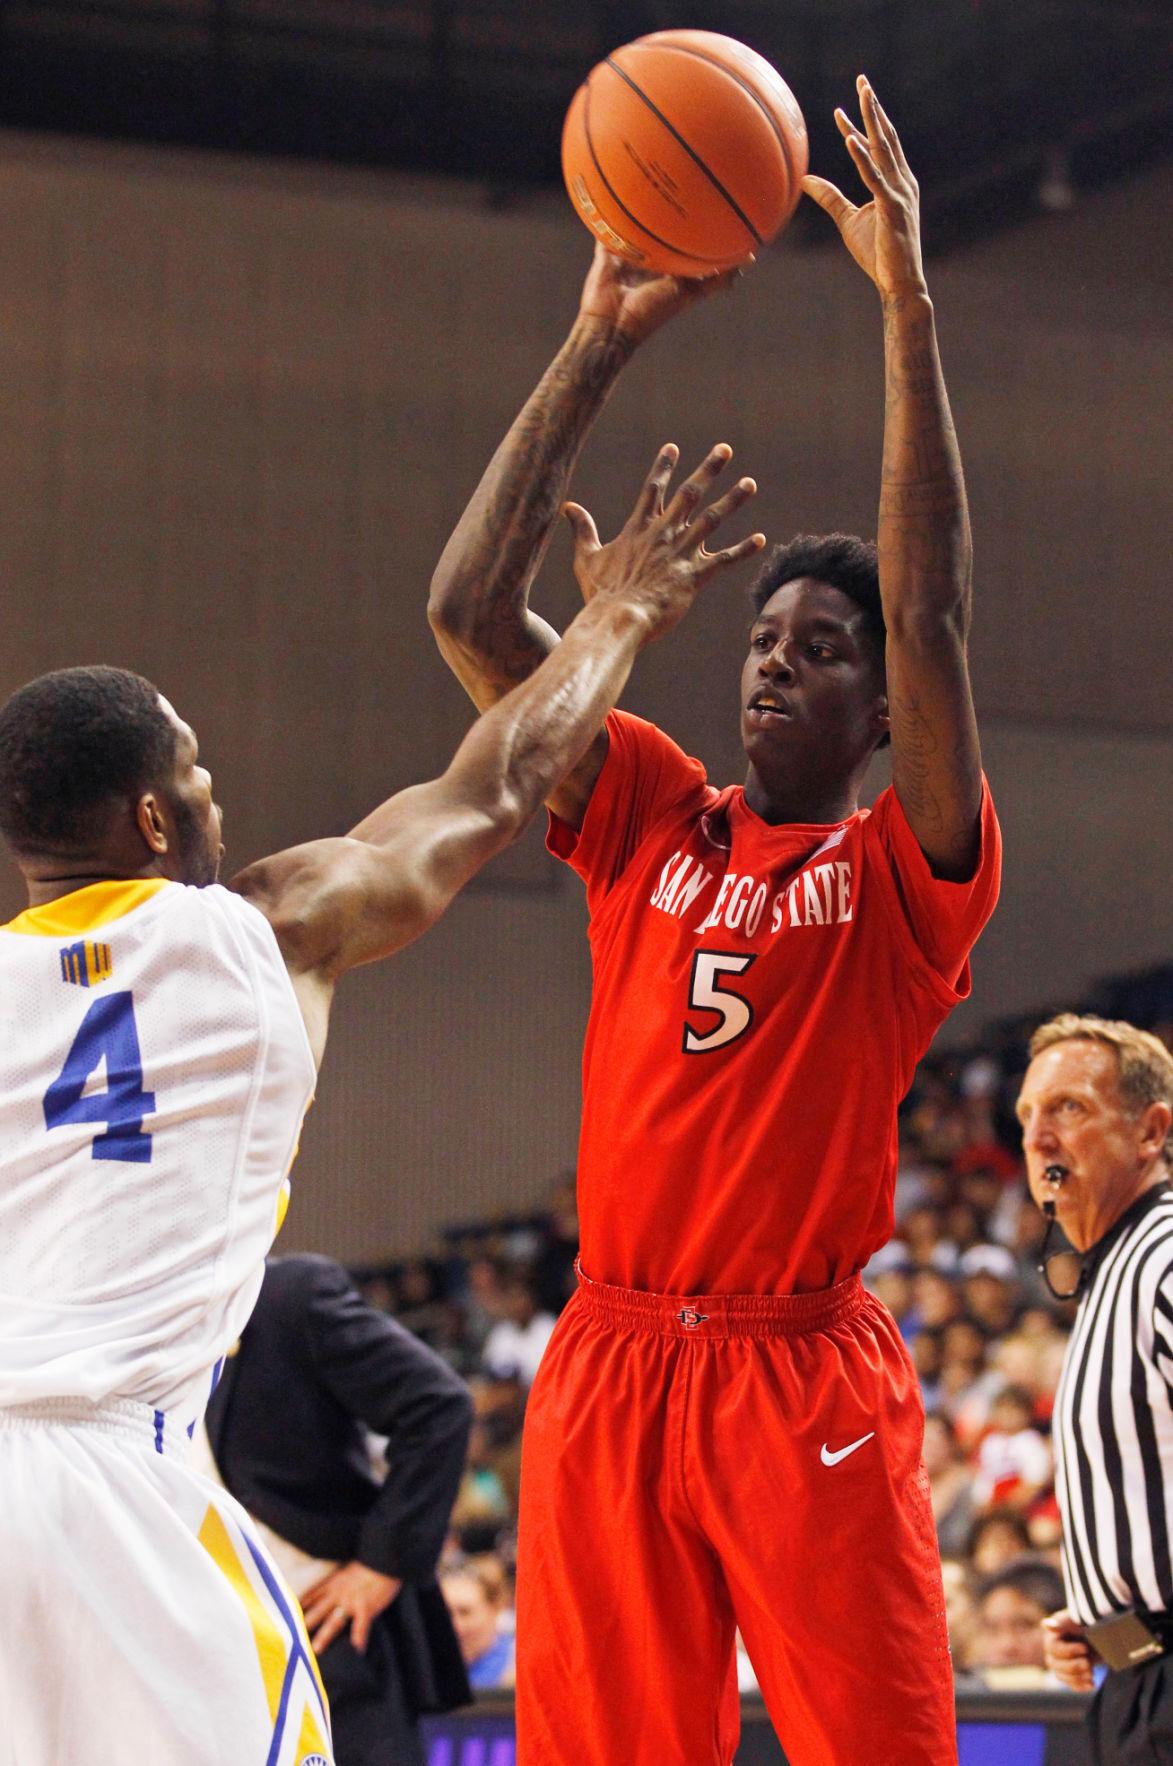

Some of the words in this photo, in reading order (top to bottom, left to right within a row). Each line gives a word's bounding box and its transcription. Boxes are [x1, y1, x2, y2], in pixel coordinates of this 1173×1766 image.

[650, 851, 714, 919] SAN
[771, 861, 854, 933] STATE
[681, 949, 760, 1054] 5
[42, 990, 156, 1163] 4
